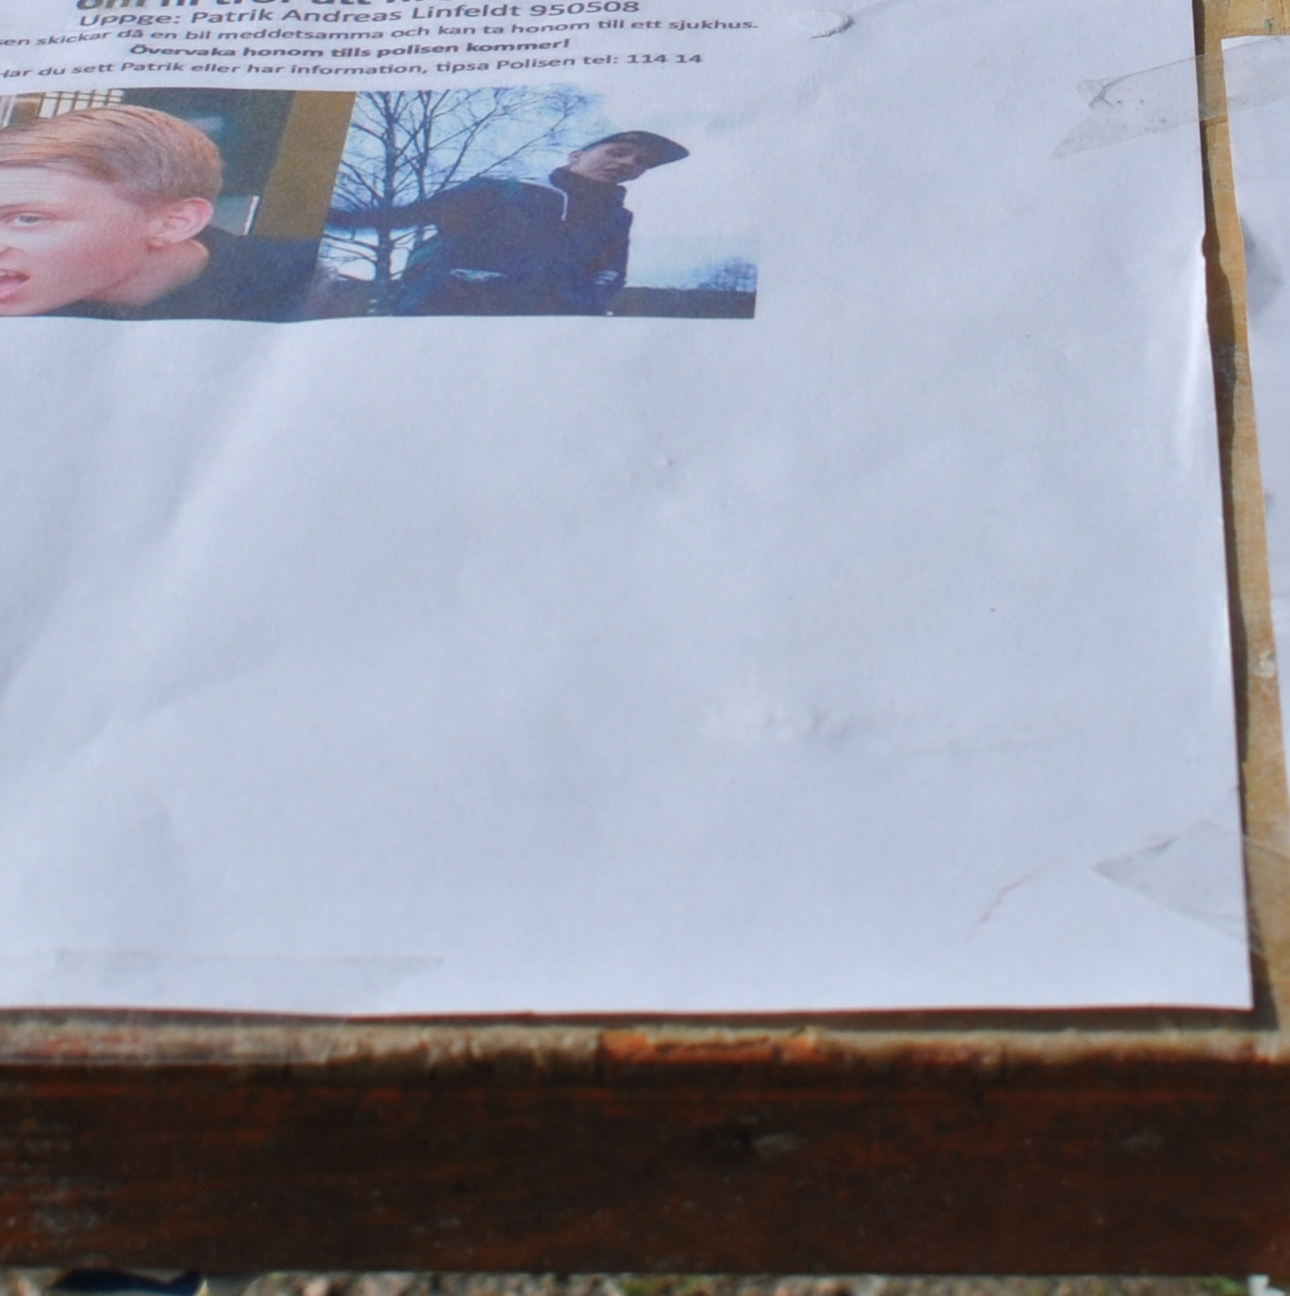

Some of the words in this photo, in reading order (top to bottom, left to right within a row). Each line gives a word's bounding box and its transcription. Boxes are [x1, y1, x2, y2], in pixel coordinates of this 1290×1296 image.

[78, 13, 181, 26] Uppge:
[190, 9, 273, 24] Patrik
[281, 10, 403, 23] Andreas
[411, 4, 521, 19] Linfeldt
[529, 1, 640, 16] 950508
[37, 31, 111, 45] skickar
[117, 29, 144, 38] då
[150, 31, 177, 39] en
[185, 31, 212, 39] bil
[217, 28, 384, 39] meddetsamma
[390, 28, 431, 38] och
[437, 25, 477, 36] kan
[483, 25, 504, 34] ta
[510, 21, 590, 34] honom
[597, 19, 625, 29] till
[631, 20, 663, 29] ett
[669, 20, 758, 30] sjukhus.
[129, 44, 236, 56] Övervaka
[243, 47, 324, 57] honom
[331, 45, 371, 57] tills
[376, 44, 459, 57] polisen
[465, 39, 570, 52] kommer!
[38, 66, 66, 75] du
[71, 64, 114, 73] sett
[120, 62, 184, 72] Patrik
[191, 64, 240, 73] eller
[247, 65, 284, 74] har
[290, 64, 428, 75] information,
[435, 60, 490, 73] tipsa
[495, 57, 576, 70] Polisen
[582, 56, 619, 65] tel:
[626, 54, 667, 64] 114
[675, 54, 703, 63] 14
